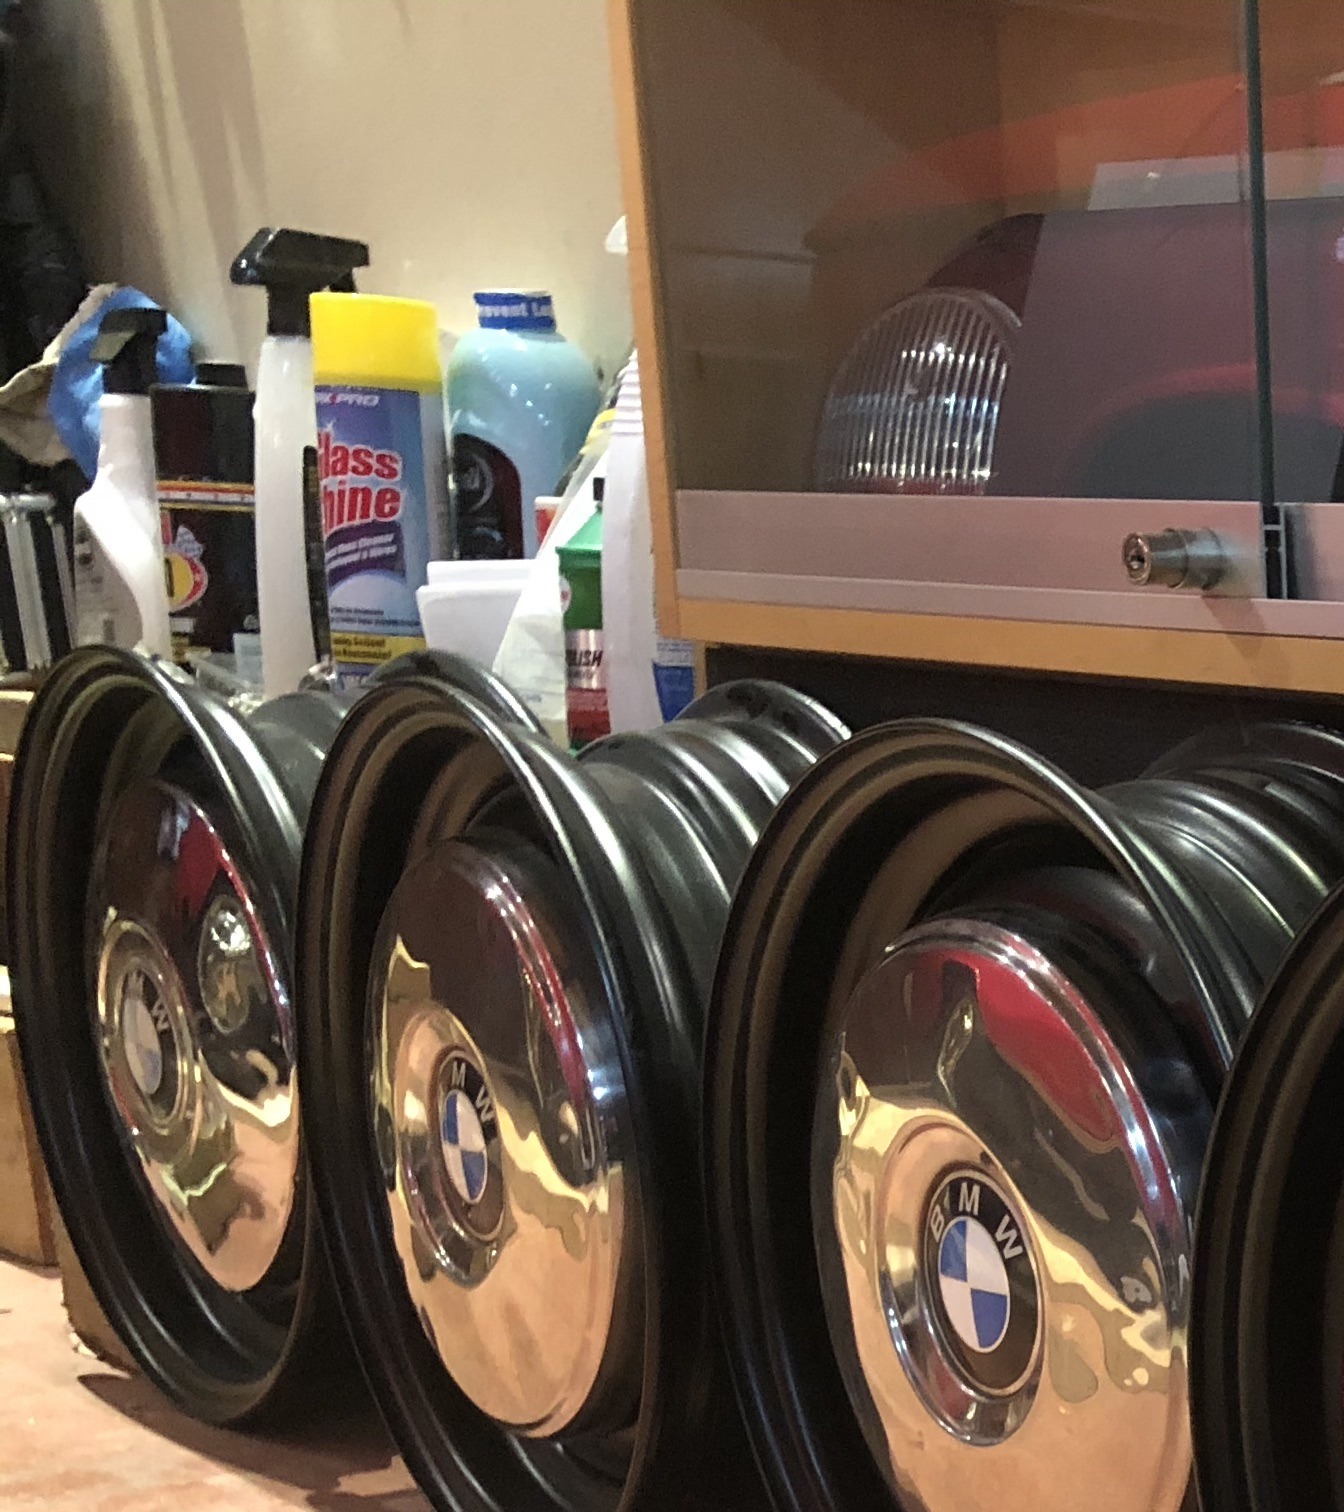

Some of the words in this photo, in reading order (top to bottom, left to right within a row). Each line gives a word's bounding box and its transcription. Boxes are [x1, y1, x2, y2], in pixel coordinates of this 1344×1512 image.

[318, 431, 402, 480] lass
[323, 480, 402, 535] hine
[450, 1060, 496, 1124] MW
[929, 1181, 1024, 1260] BMW
